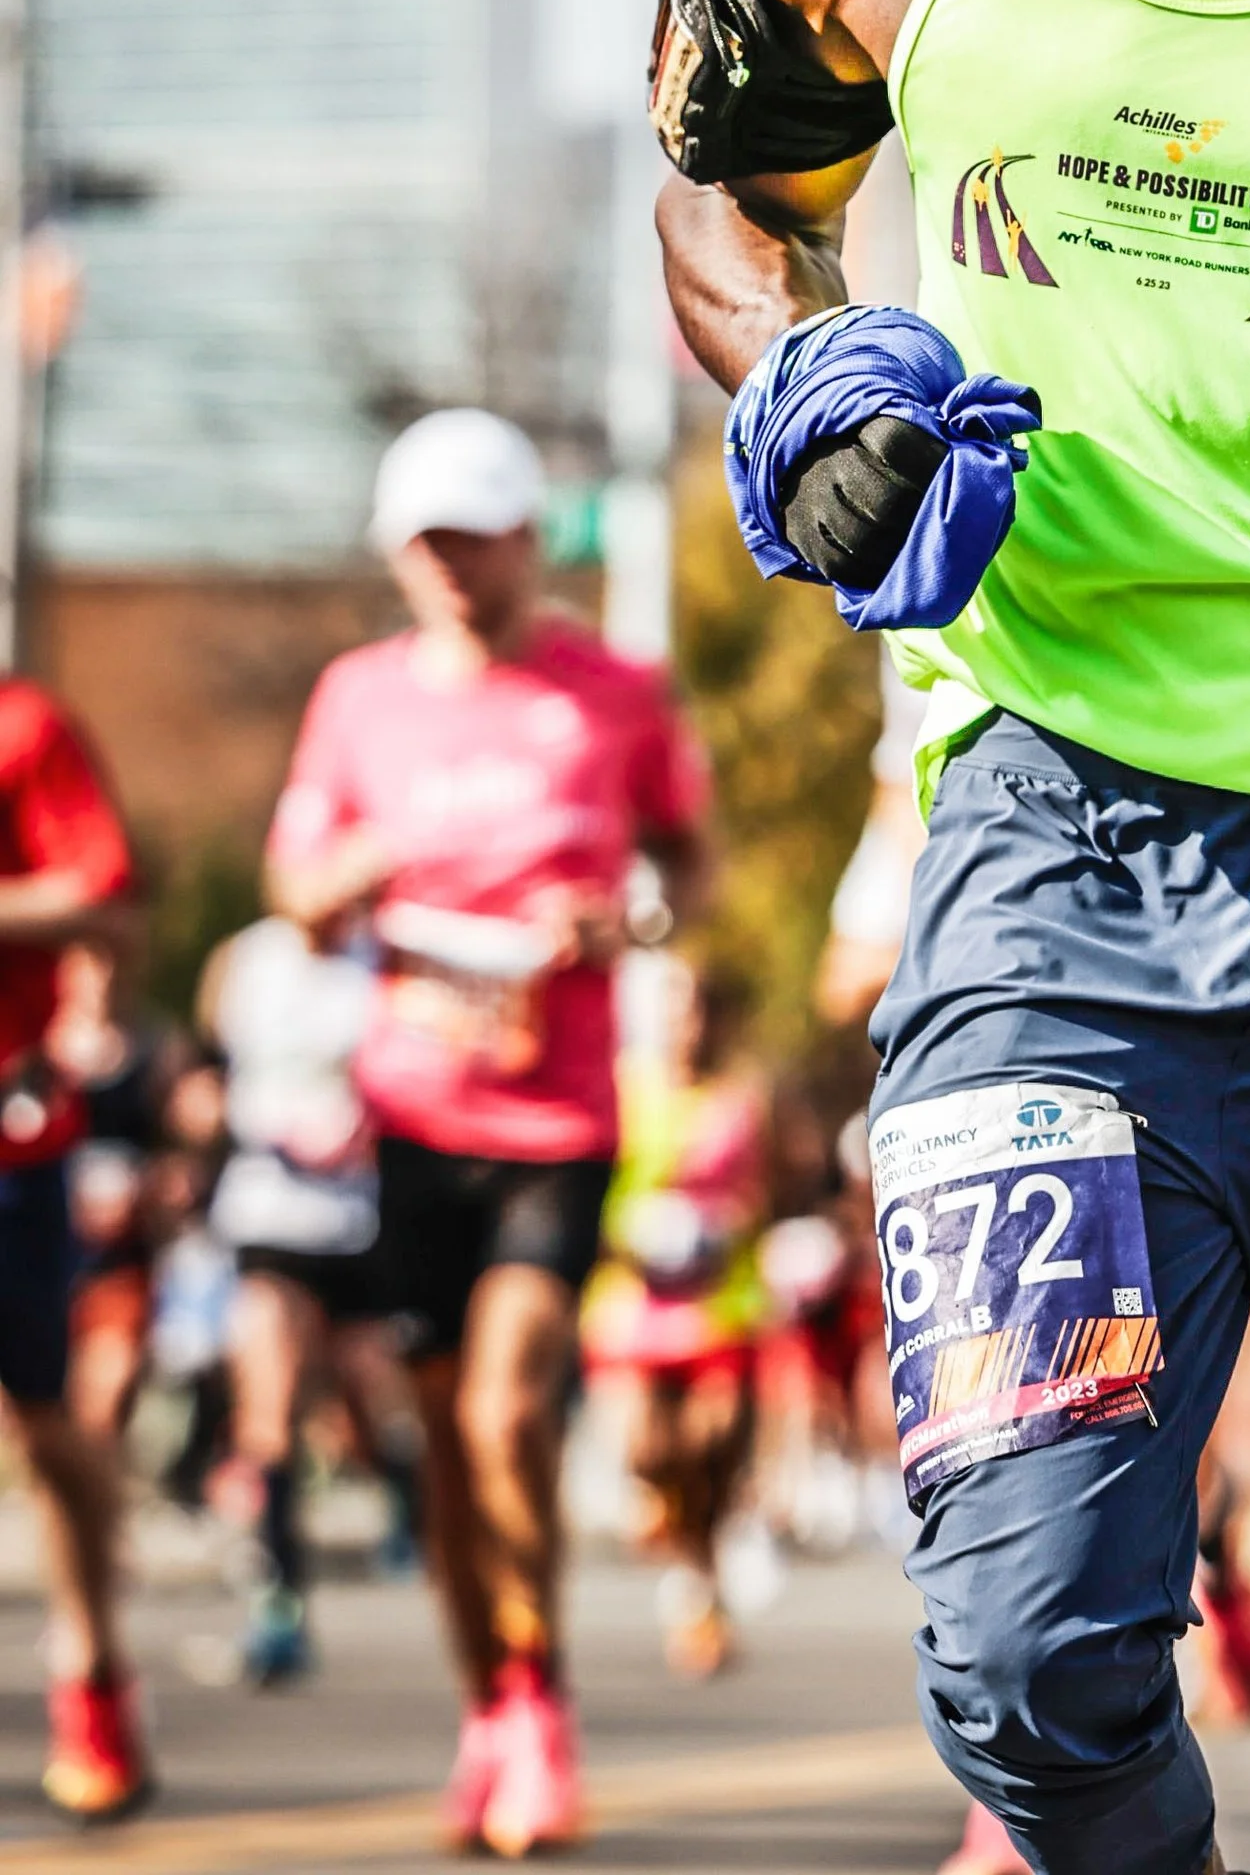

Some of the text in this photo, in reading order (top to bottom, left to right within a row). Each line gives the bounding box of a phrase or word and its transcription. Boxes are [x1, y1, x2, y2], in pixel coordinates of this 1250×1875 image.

[1114, 106, 1197, 135] Achilles
[1058, 154, 1110, 184] HOPE
[1112, 165, 1131, 189] &
[1106, 199, 1167, 219] PRESENTED
[1170, 212, 1183, 223] BY
[1194, 210, 1216, 229] TD
[1119, 247, 1143, 258] NEW
[1146, 250, 1172, 263] YORK
[1174, 256, 1202, 269] ROAD
[1205, 262, 1250, 275] RUNNERS
[1136, 276, 1171, 290] 6 25 23
[877, 1132, 907, 1156] TATA
[1011, 1131, 1074, 1152] TATA
[877, 1173, 1084, 1350] 872
[905, 1318, 970, 1356] CORRAL
[970, 1305, 993, 1333] B
[1040, 1379, 1099, 1405] 2023
